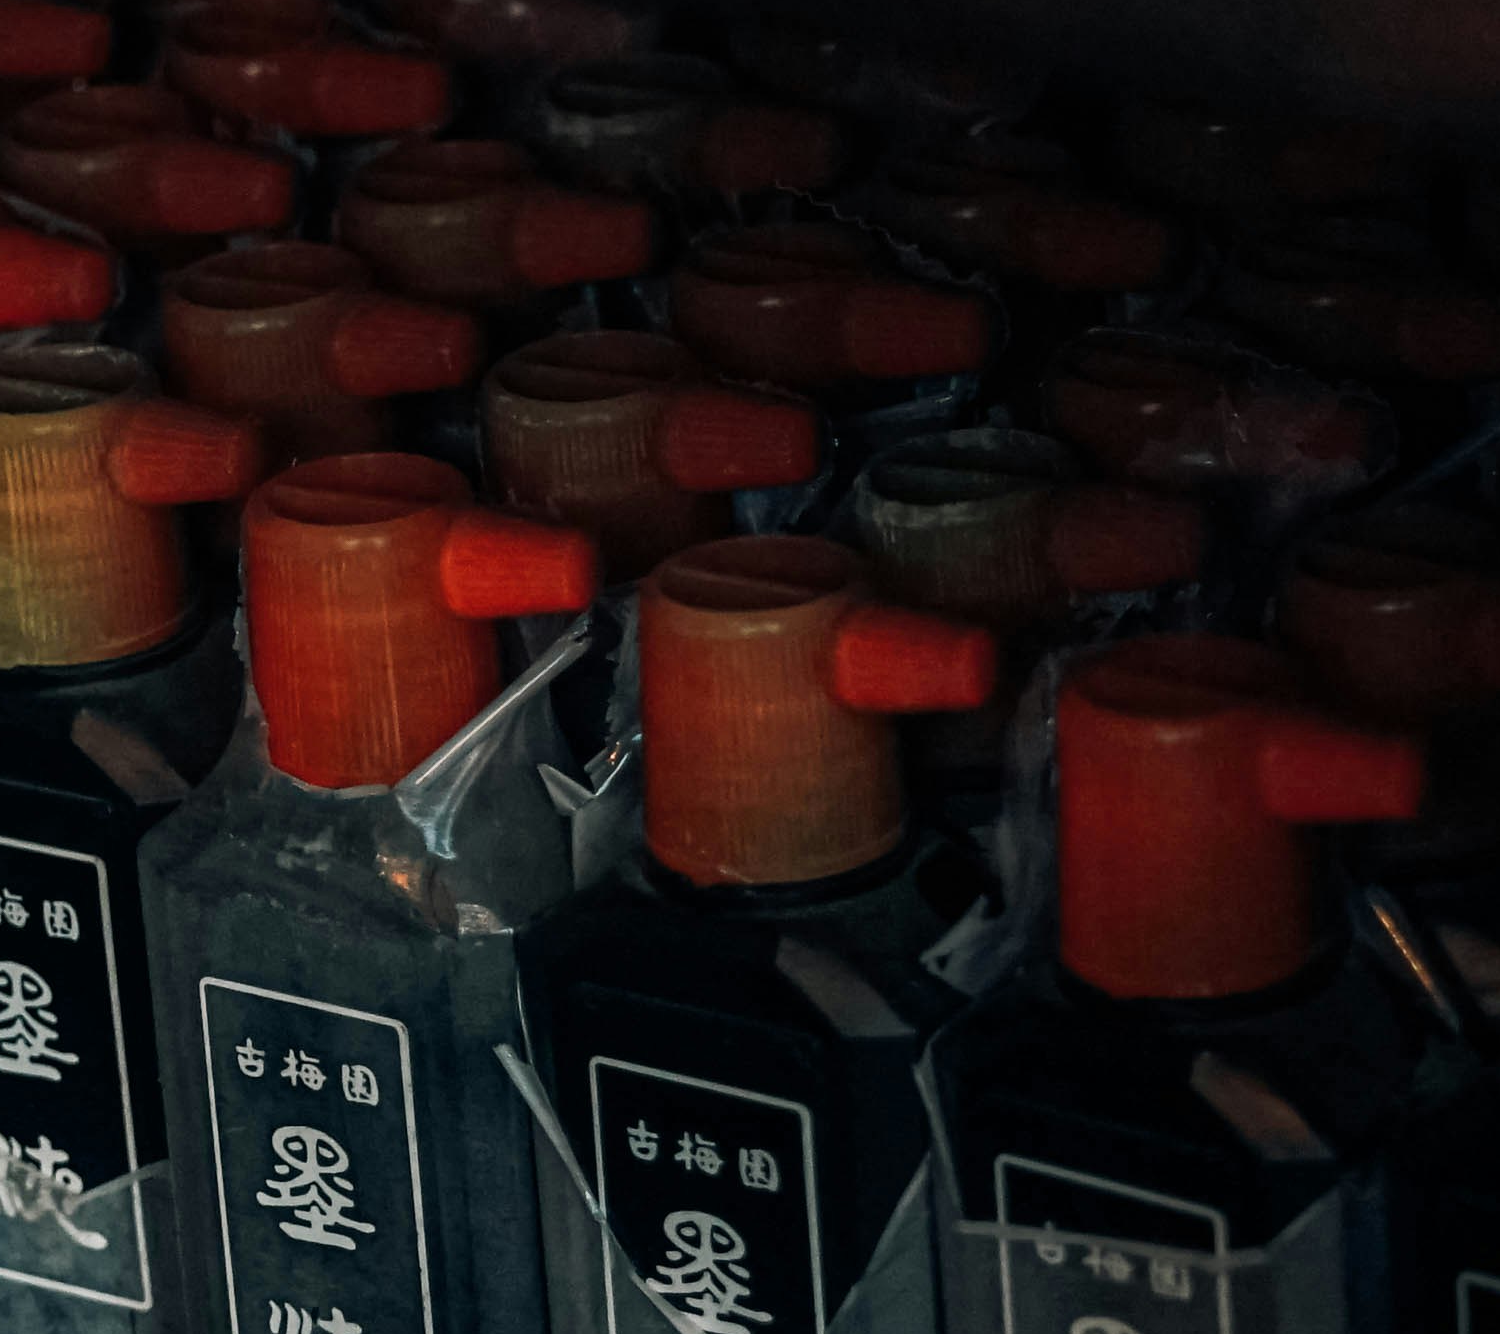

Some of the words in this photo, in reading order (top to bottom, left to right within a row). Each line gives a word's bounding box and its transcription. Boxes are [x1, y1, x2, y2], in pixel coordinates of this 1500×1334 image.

[234, 1037, 379, 1106] 古梅園
[625, 1118, 782, 1194] 古梅園
